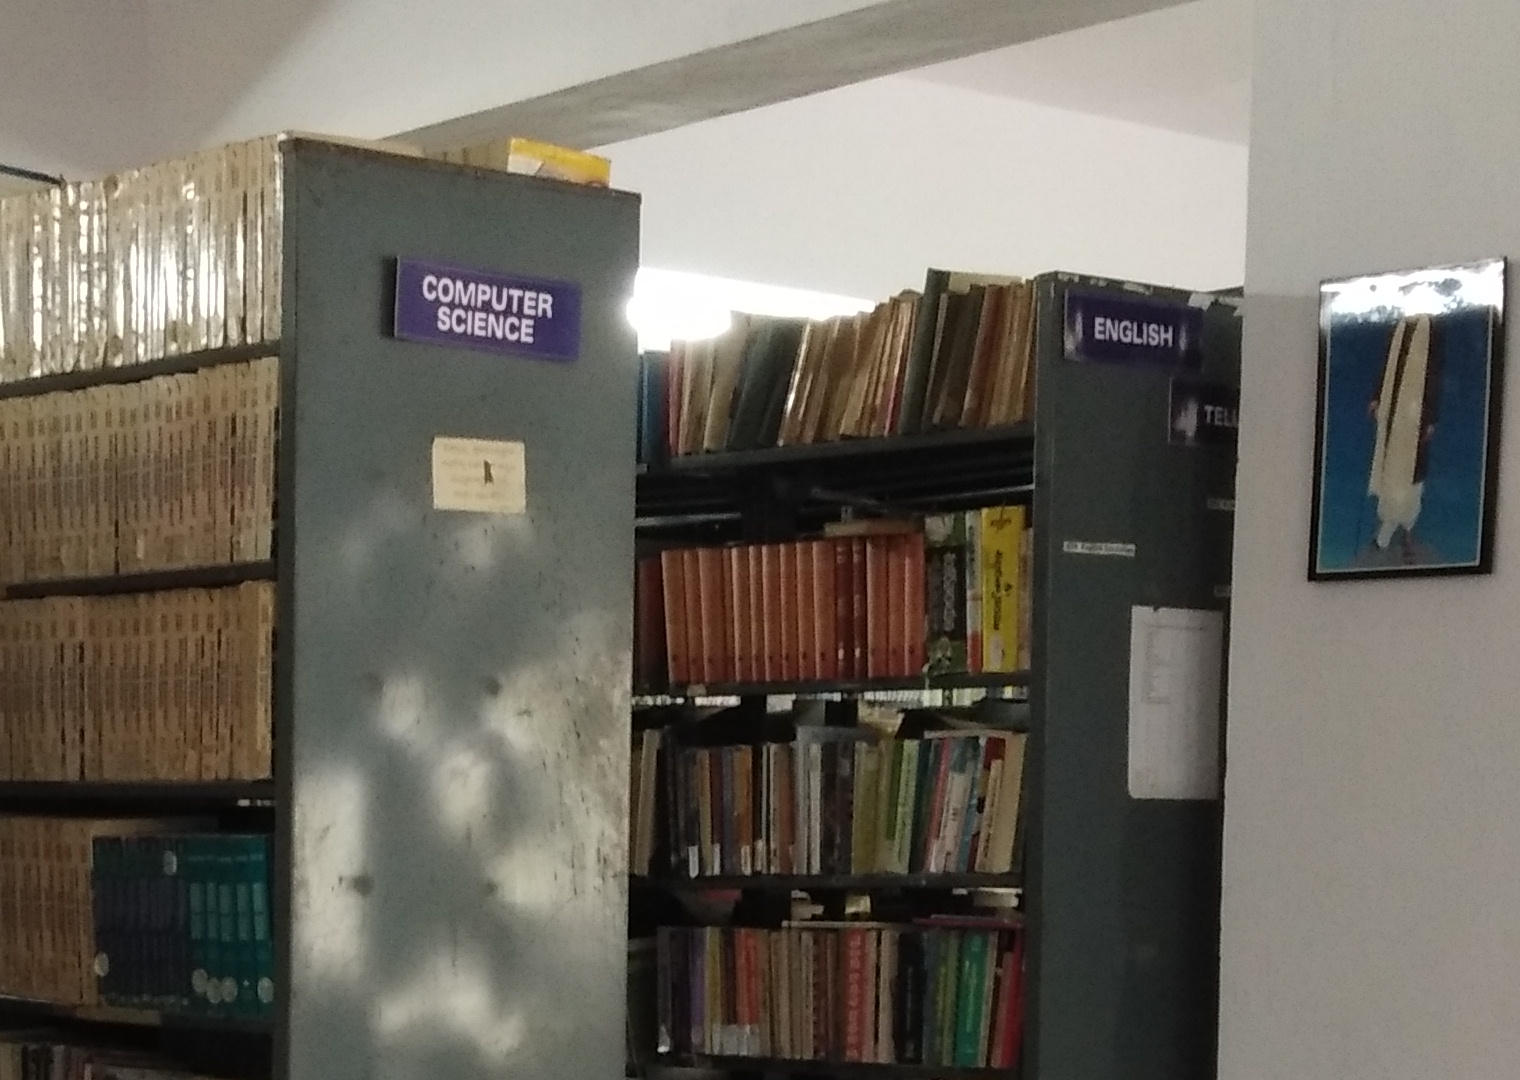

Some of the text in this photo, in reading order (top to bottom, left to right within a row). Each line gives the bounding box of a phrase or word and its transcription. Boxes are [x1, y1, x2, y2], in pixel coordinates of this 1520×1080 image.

[421, 273, 554, 320] COMPUTER
[436, 305, 535, 345] SCIENCE
[1093, 316, 1174, 349] ENGLISH
